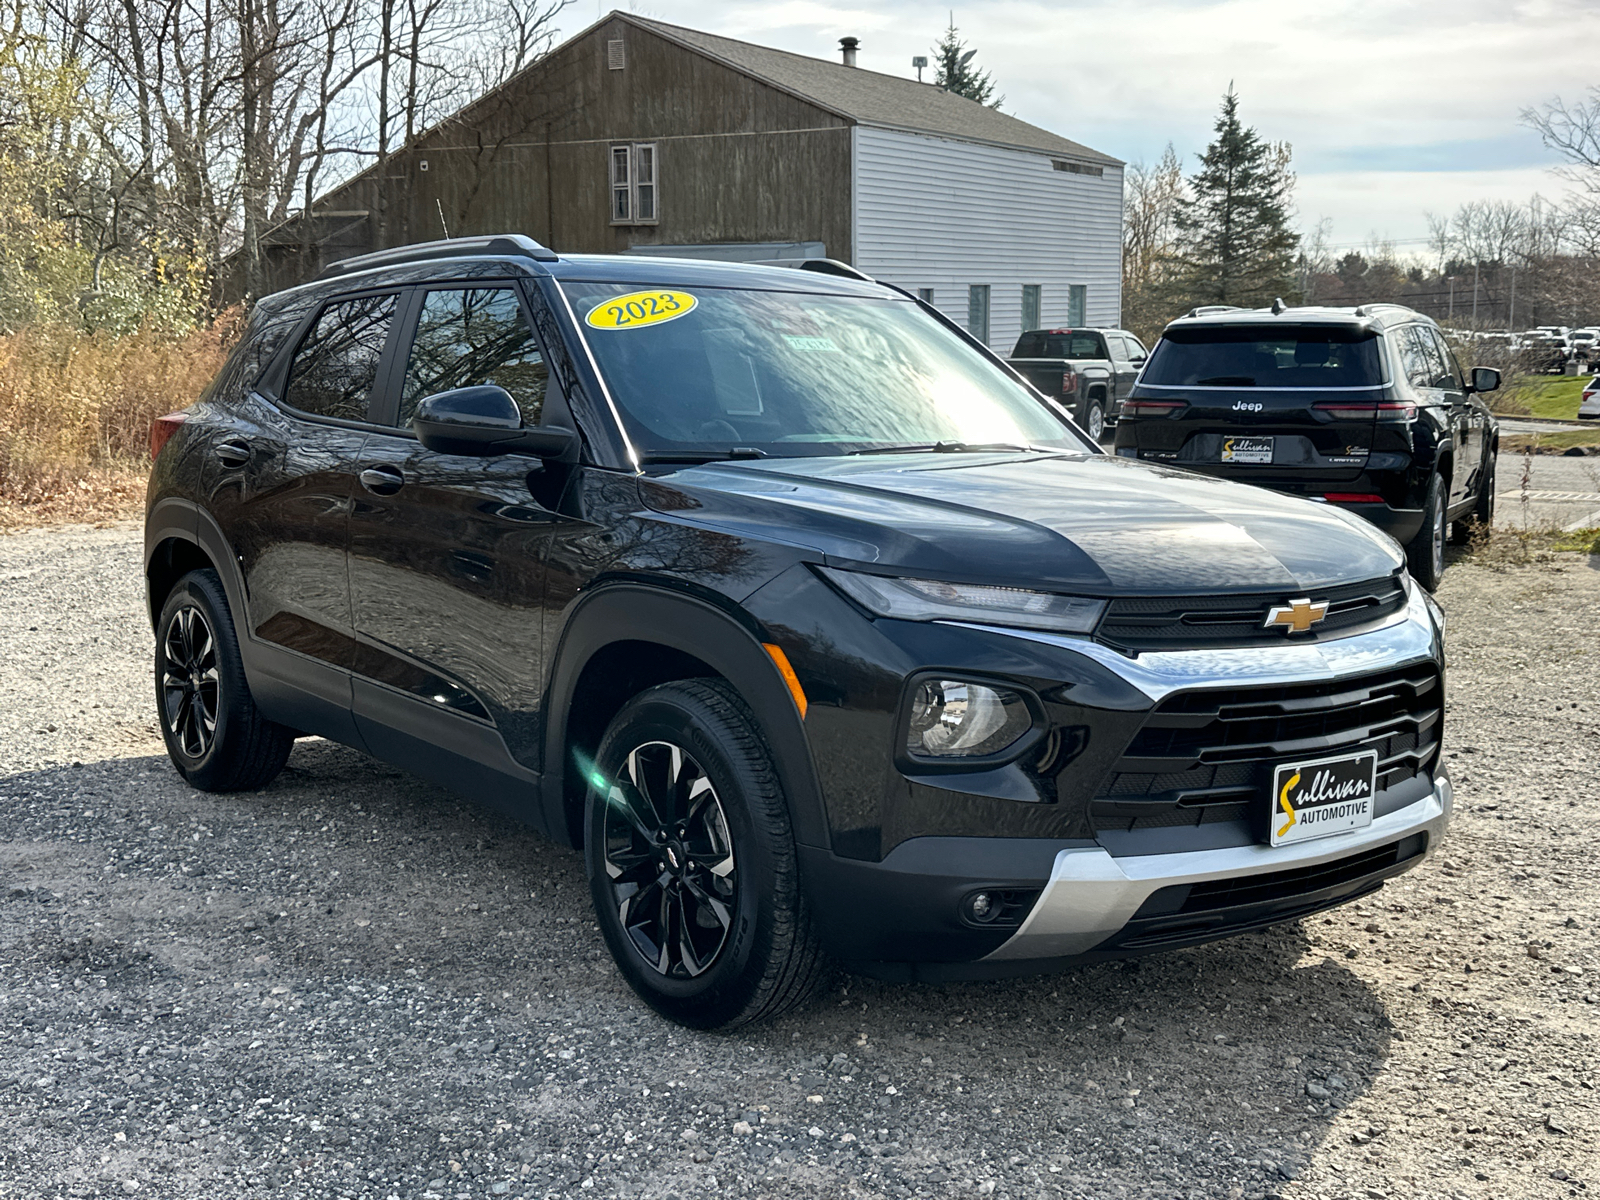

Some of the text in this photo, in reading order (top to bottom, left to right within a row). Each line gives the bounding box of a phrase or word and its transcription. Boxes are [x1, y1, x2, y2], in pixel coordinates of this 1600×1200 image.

[607, 293, 681, 326] 2023
[1232, 400, 1263, 413] Jeep
[1223, 439, 1271, 459] Sullivan
[1276, 769, 1369, 838] Sullivan
[1299, 801, 1368, 826] AUTOMOTIVE
